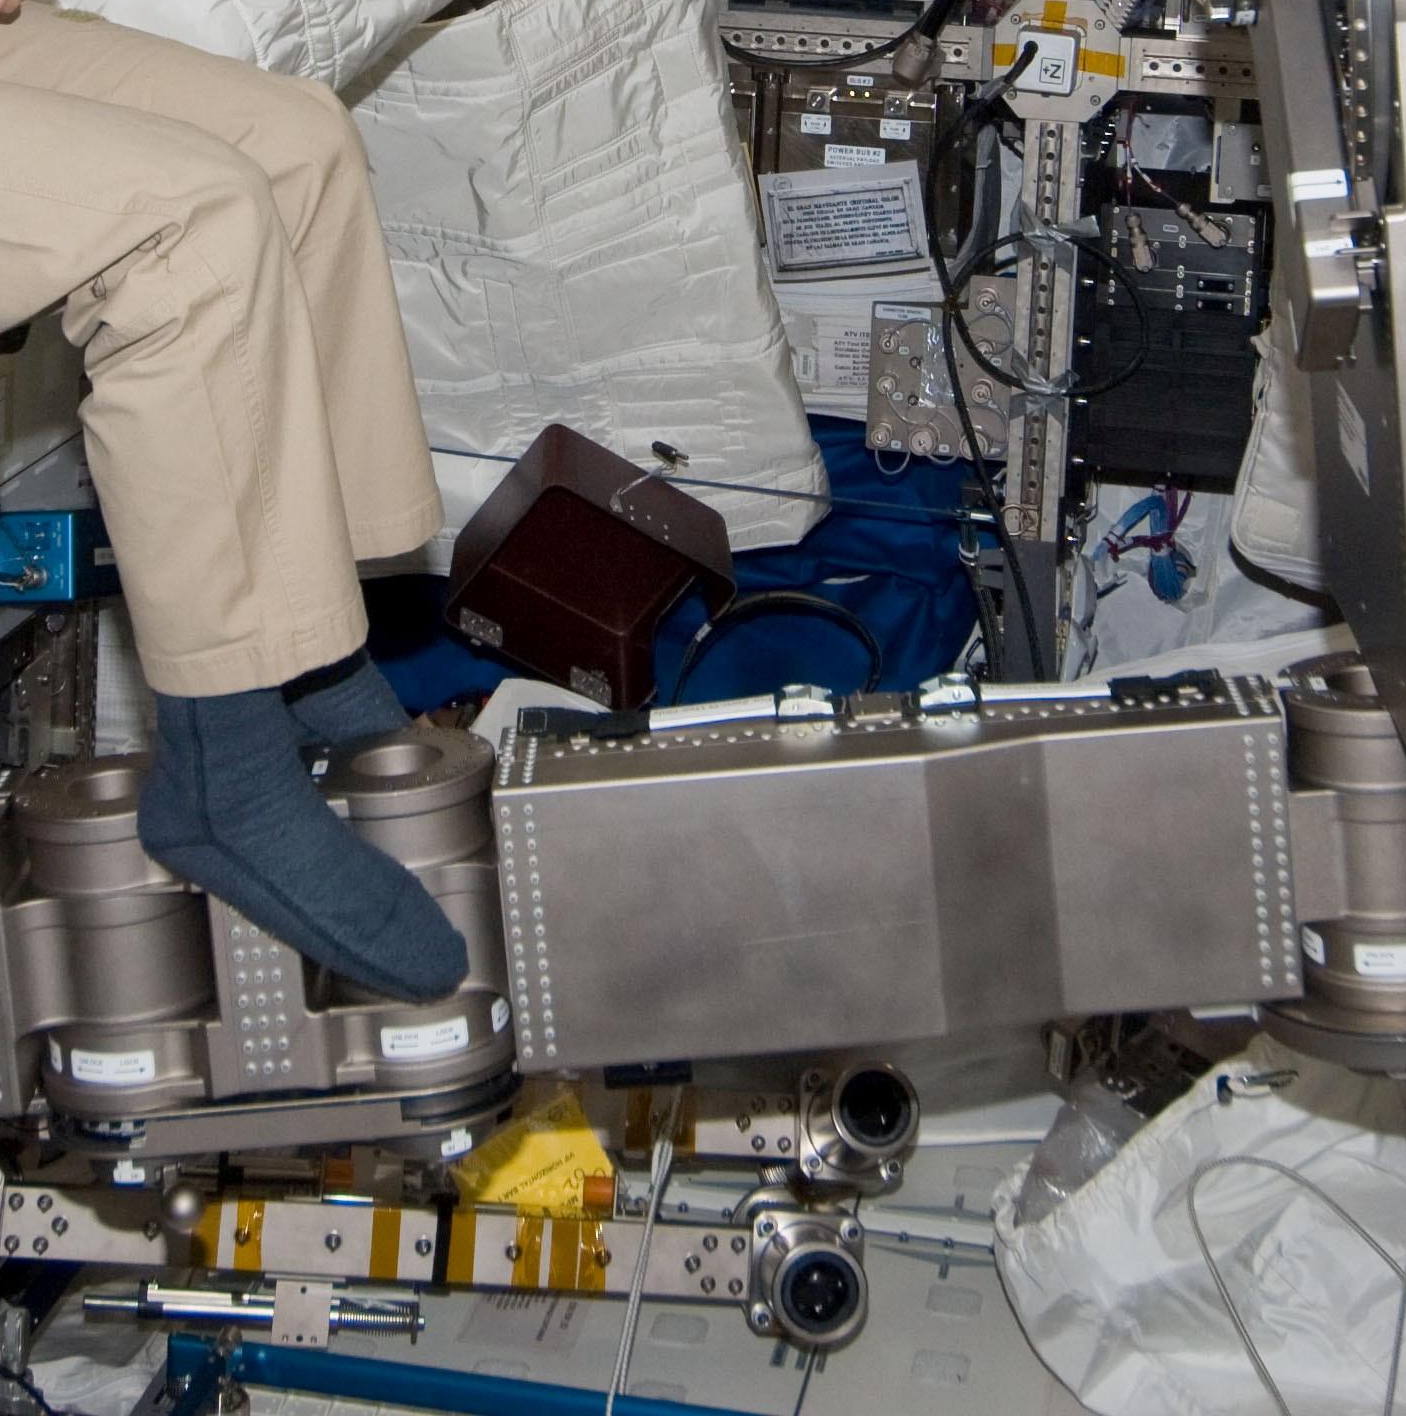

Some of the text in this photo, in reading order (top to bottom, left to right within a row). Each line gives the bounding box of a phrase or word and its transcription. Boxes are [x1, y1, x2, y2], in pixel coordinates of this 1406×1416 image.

[827, 146, 881, 157] POWER BUS #2
